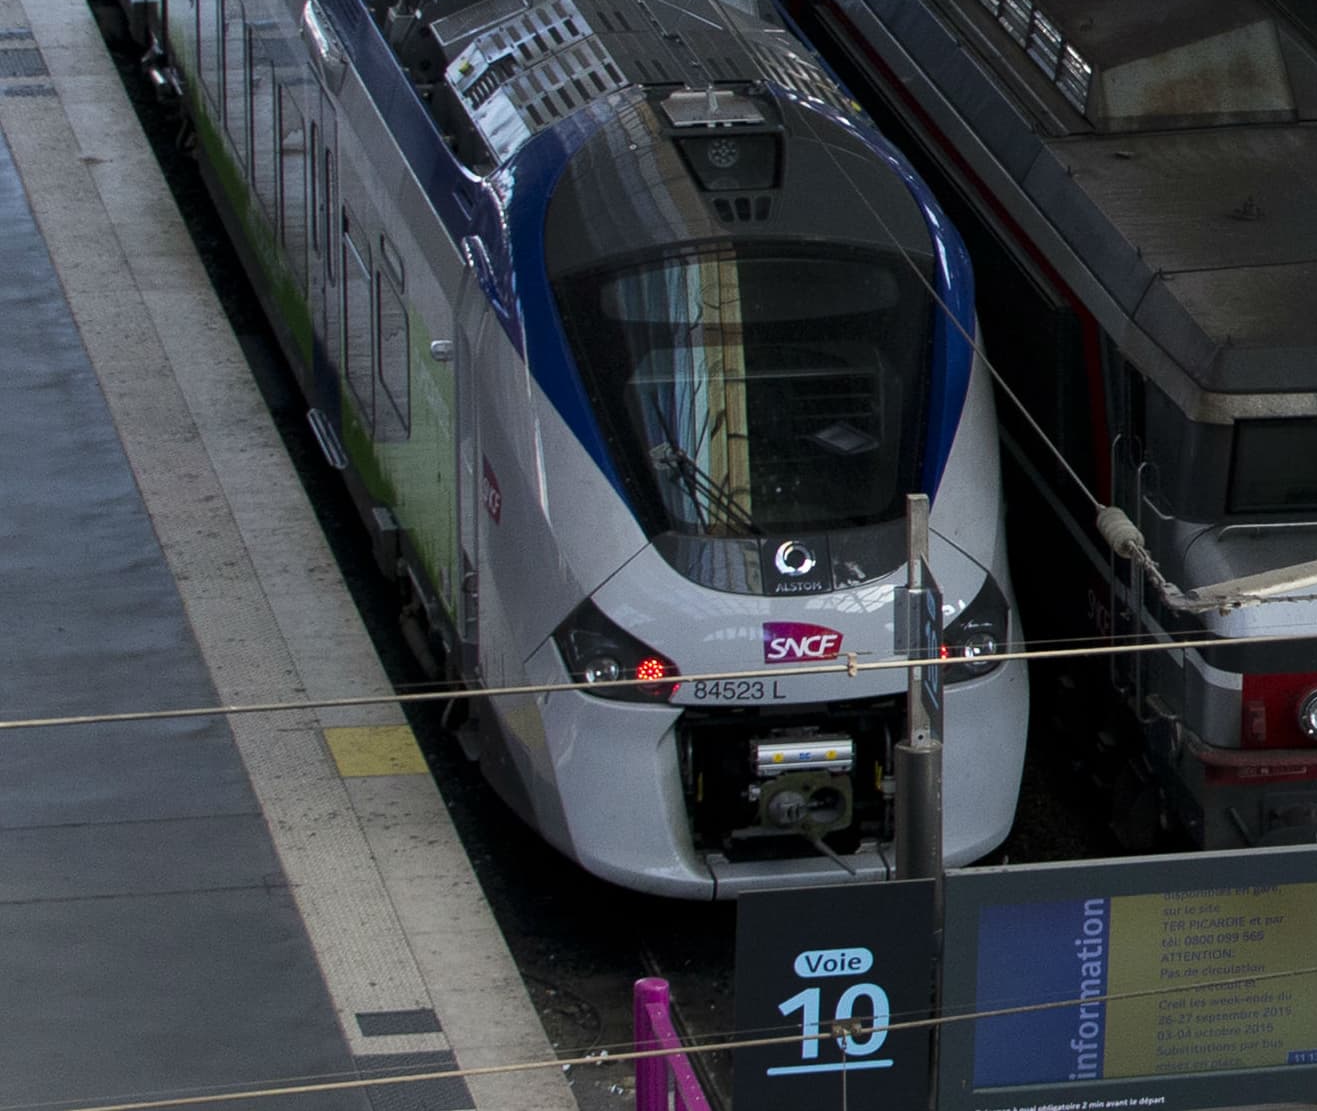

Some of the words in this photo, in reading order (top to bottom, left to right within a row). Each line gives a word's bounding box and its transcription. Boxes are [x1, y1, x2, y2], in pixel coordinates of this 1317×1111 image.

[775, 581, 823, 593] ALSTOM
[767, 634, 839, 659] SNCF
[694, 681, 765, 700] 84523
[773, 682, 787, 699] L
[1163, 908, 1181, 917] sur
[1162, 921, 1186, 931] TER
[1189, 917, 1246, 930] PICARDIE
[1249, 916, 1261, 926] et
[1265, 915, 1285, 926] par
[803, 952, 862, 973] Voie
[1160, 969, 1179, 979] Pas
[1184, 967, 1199, 977] de
[1202, 963, 1265, 976] circulation
[1068, 898, 1104, 1079] information
[777, 982, 890, 1060] 10
[1082, 1101, 1088, 1109] 2
[1089, 1100, 1105, 1108] min
[1106, 1098, 1129, 1107] avant
[1130, 1097, 1138, 1105] le
[1139, 1096, 1165, 1106] départ
